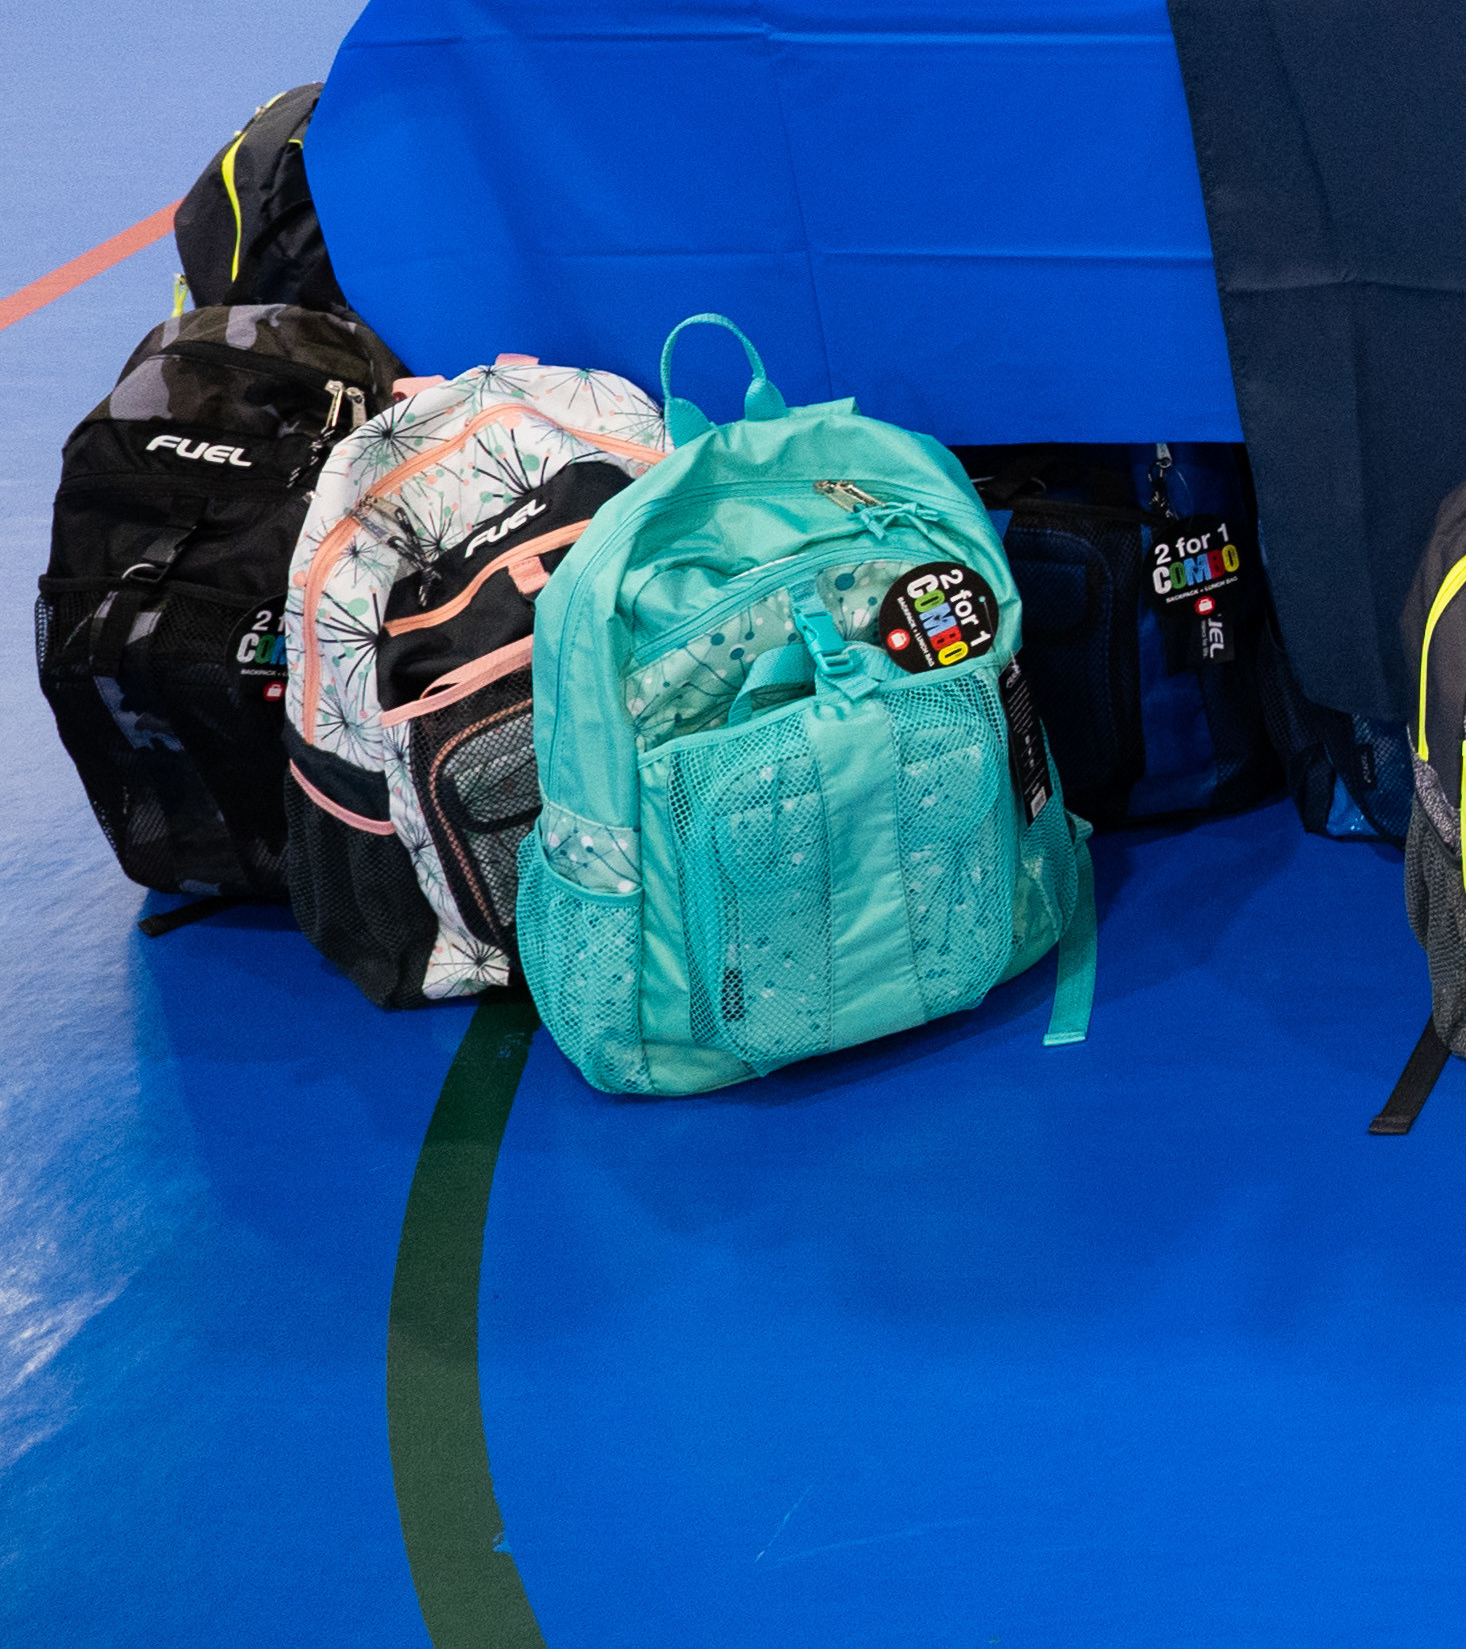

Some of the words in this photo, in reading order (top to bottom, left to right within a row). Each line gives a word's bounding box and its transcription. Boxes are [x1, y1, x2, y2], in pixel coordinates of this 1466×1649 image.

[144, 435, 252, 467] FUEL
[465, 498, 545, 558] FUEL
[1154, 543, 1171, 565] 2
[1175, 533, 1211, 558] for
[1217, 523, 1229, 542] 1
[939, 569, 964, 590] 2
[1152, 544, 1239, 594] COMBO
[252, 610, 272, 631] 2
[906, 573, 969, 666] COMBO
[950, 589, 979, 627] for
[970, 630, 992, 647] 1
